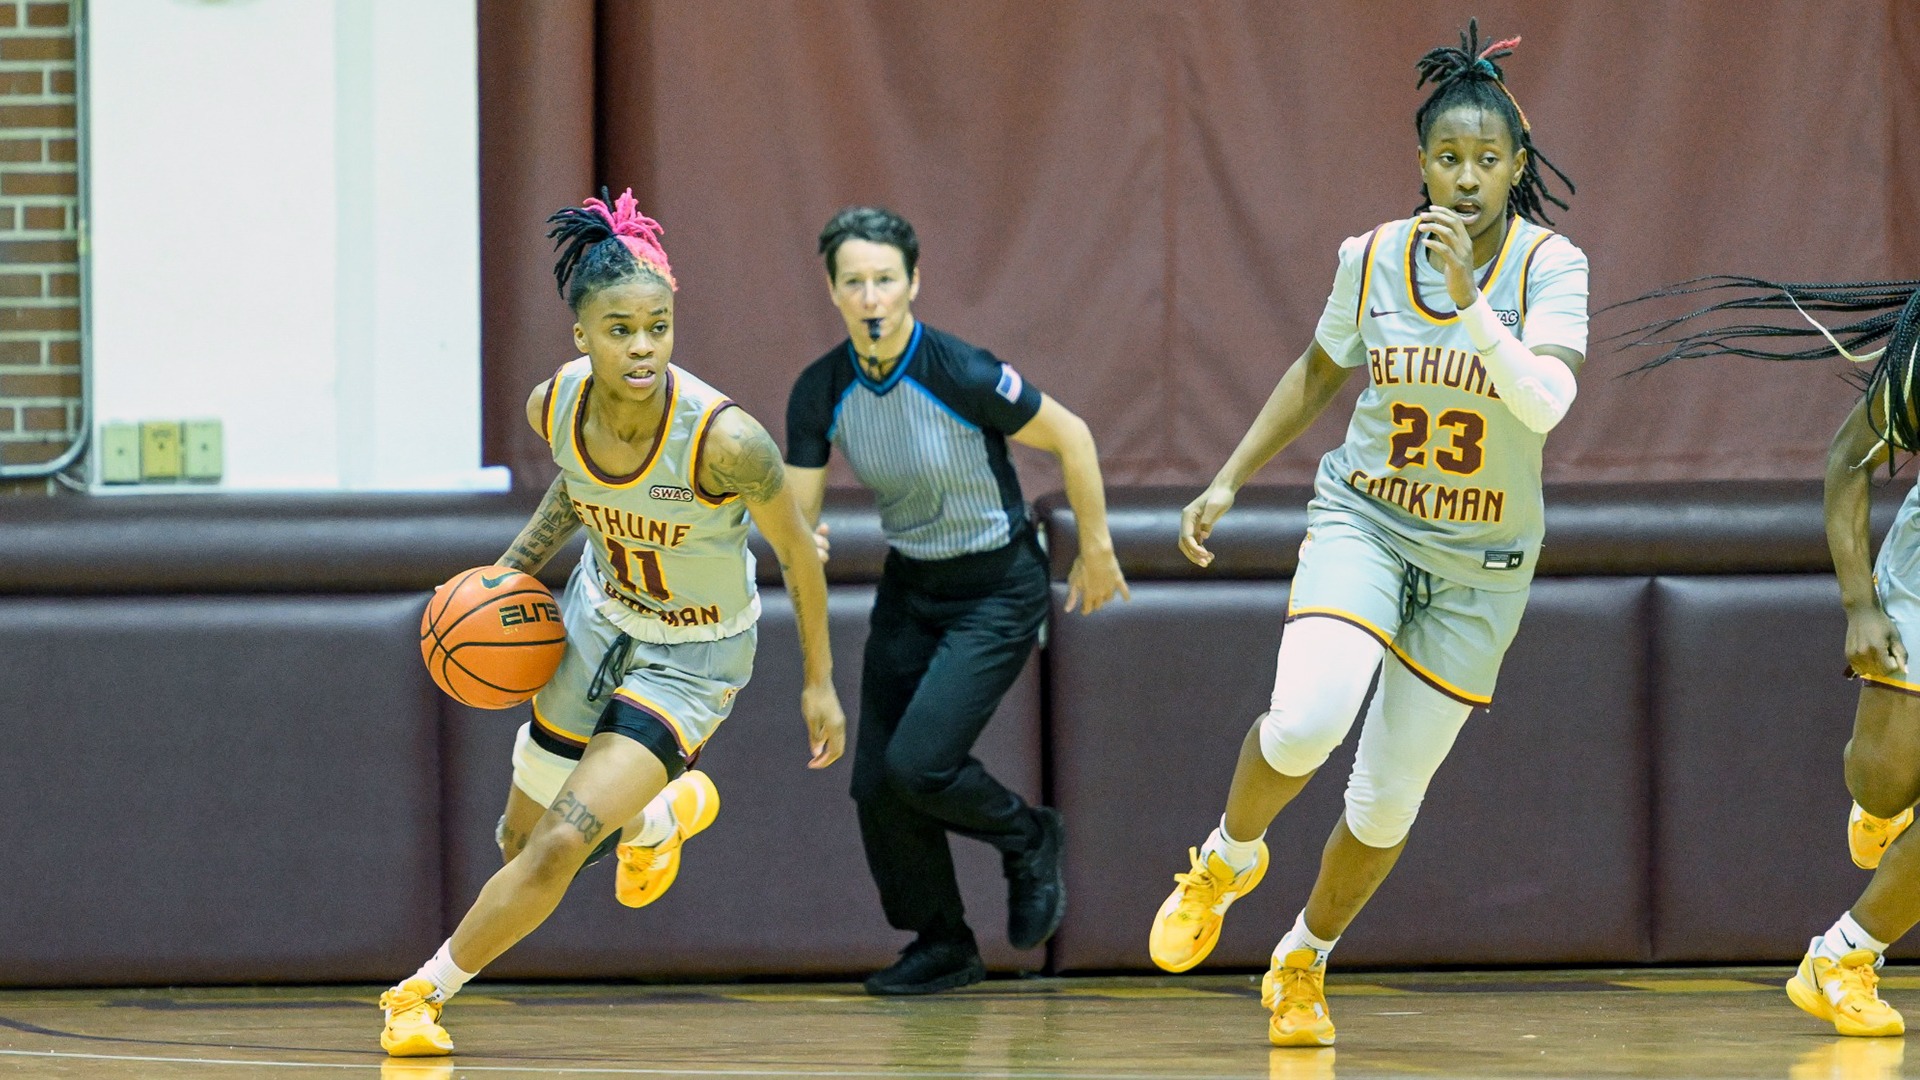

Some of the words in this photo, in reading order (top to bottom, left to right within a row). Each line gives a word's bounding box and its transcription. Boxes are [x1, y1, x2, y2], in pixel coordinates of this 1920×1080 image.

[1389, 403, 1485, 475] 23
[651, 487, 693, 501] SWAC
[572, 499, 691, 548] ETHUNE
[605, 536, 671, 601] 11
[499, 602, 562, 627] ELITE
